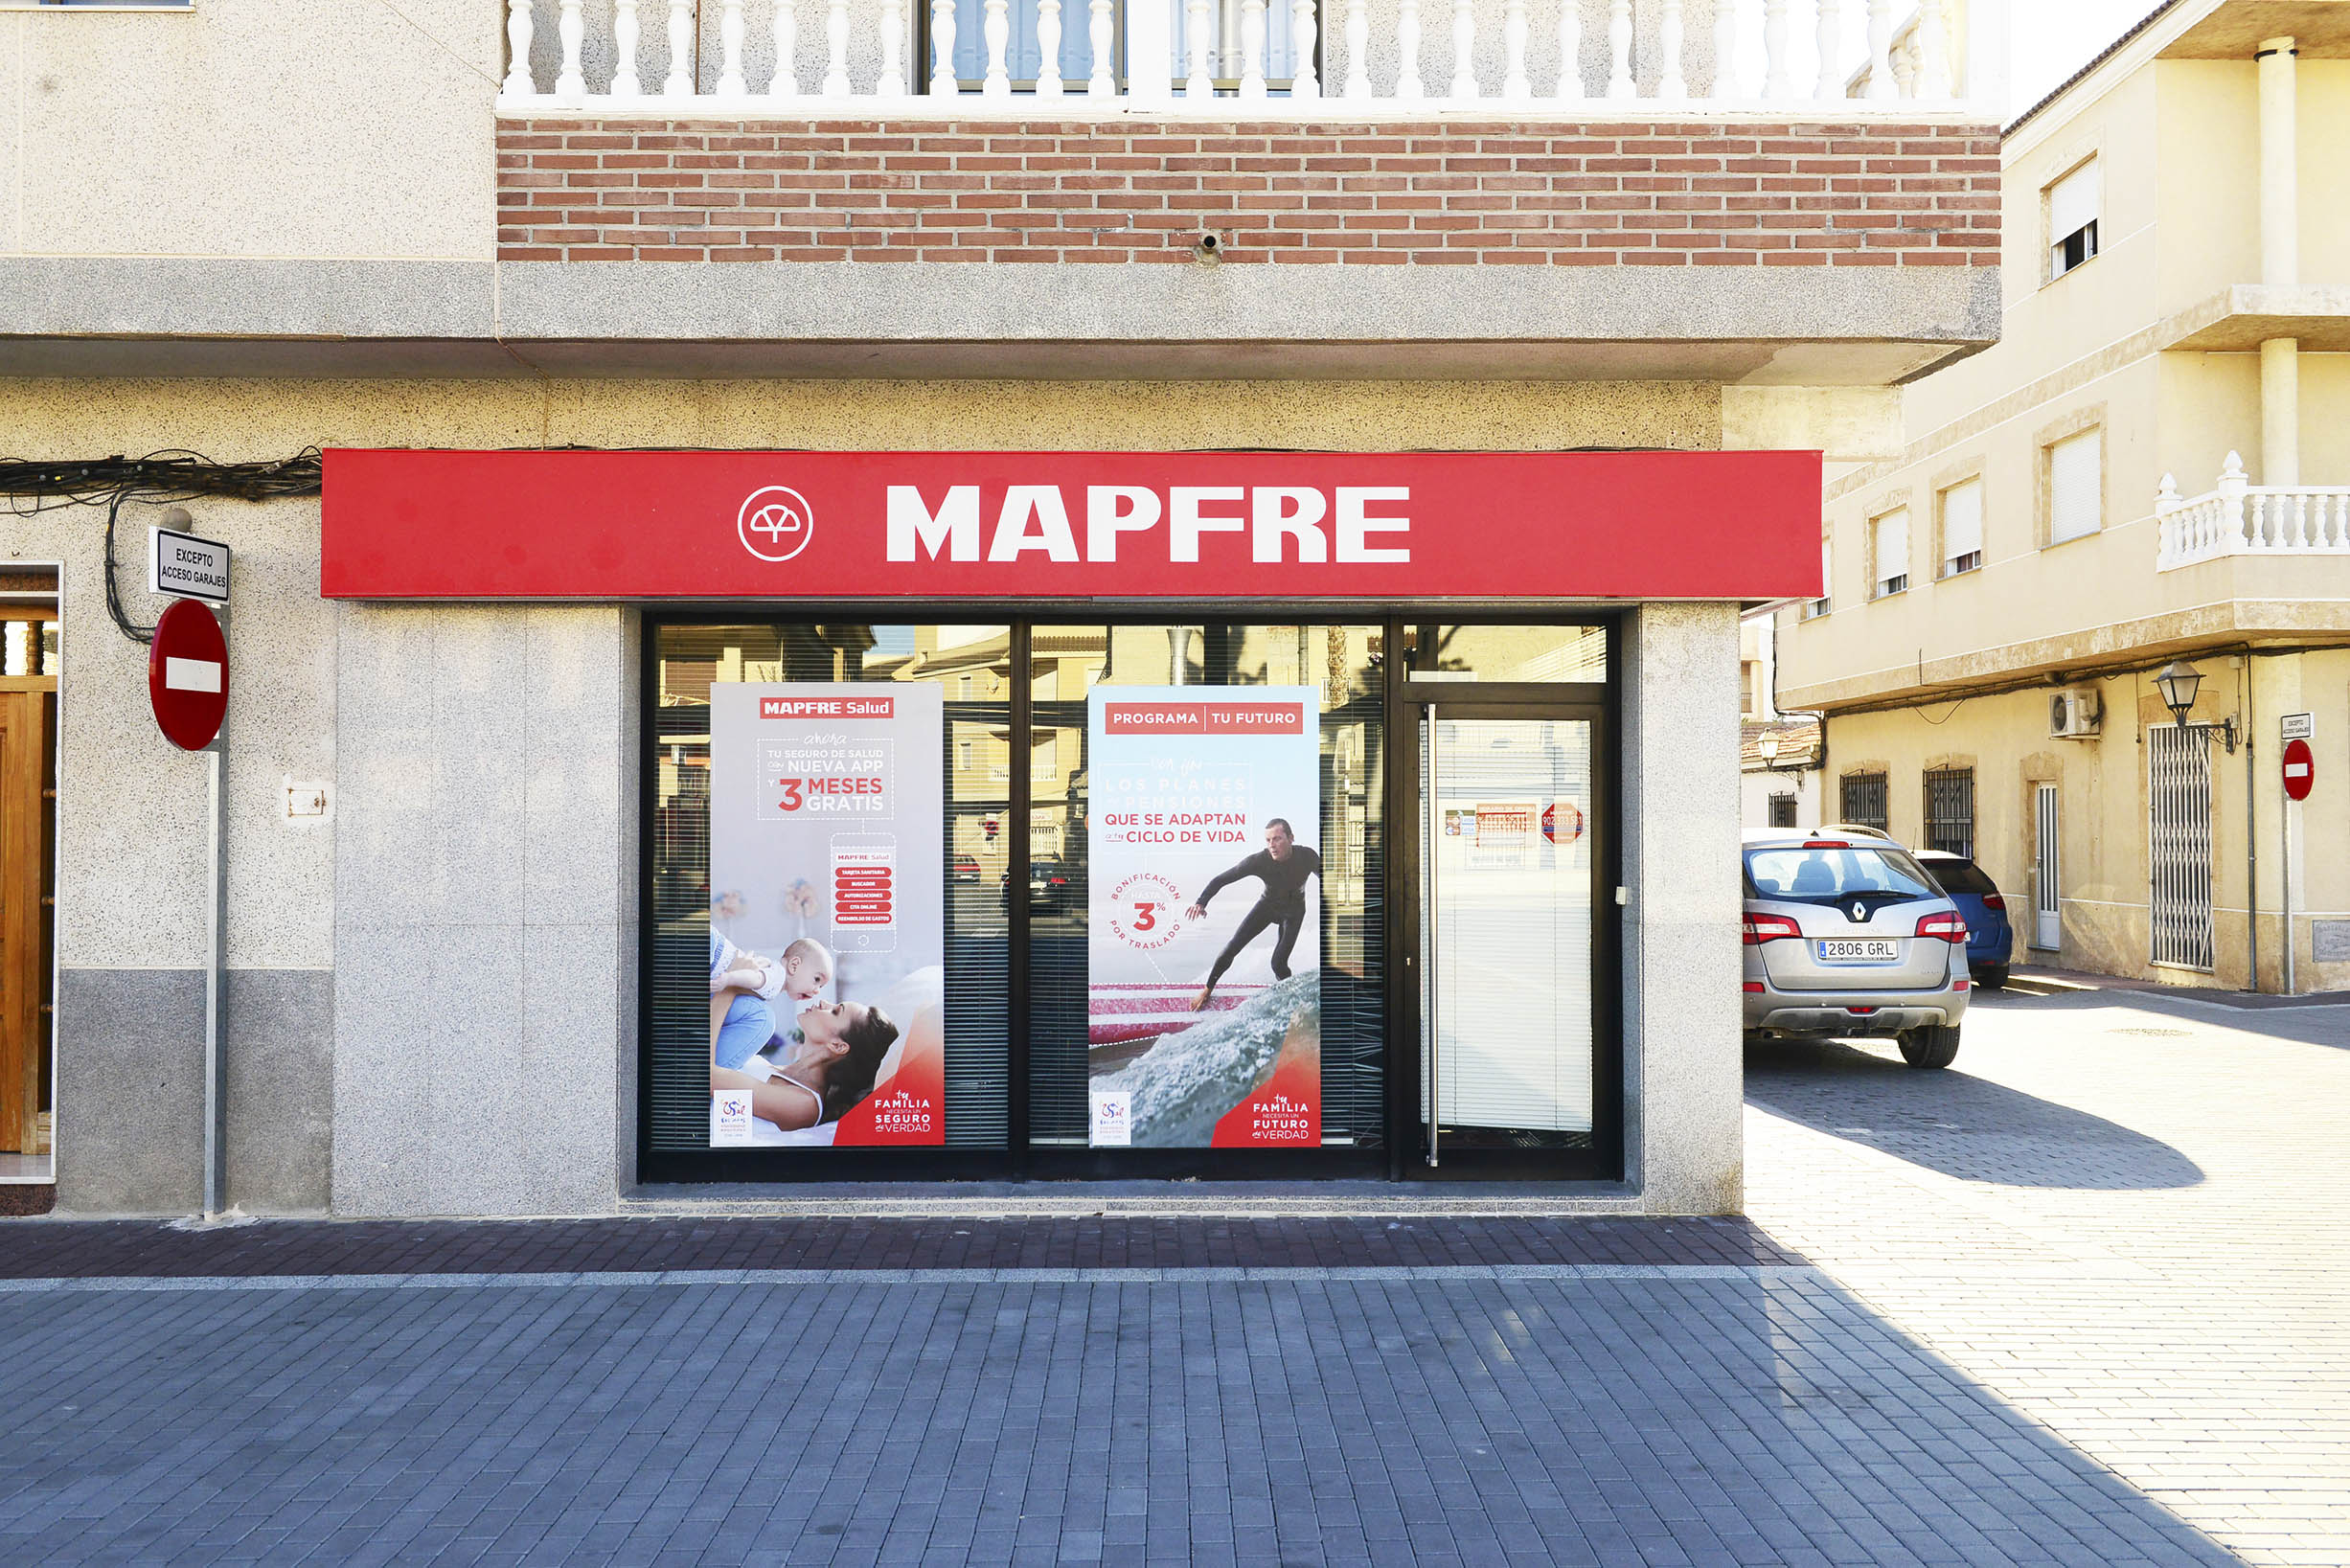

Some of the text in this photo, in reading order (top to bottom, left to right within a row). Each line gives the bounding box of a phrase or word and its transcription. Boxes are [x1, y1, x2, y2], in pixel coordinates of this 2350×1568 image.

[886, 485, 1410, 563] MAPFRE
[176, 548, 213, 567] EXCEPTO
[162, 565, 226, 587] ACCESO GARAJES
[764, 700, 889, 715] MAPFRE Salud
[1113, 713, 1296, 724] PROGRAMA TU FUTURO
[803, 733, 848, 745] ahora
[767, 750, 883, 759] TU SEGURO DE SALUD
[787, 761, 846, 773] NUEVA
[851, 761, 883, 773] APP
[1105, 779, 1245, 791] LOS PLANES
[778, 778, 803, 811] 3
[808, 778, 882, 794] MESES
[807, 796, 883, 811] GRATIS
[1126, 796, 1246, 809] PENSIONES
[1105, 813, 1245, 826] QUE SE ADAPTAN
[1542, 815, 1555, 826] 902
[1127, 830, 1175, 843] CICLO
[1180, 830, 1201, 843] DE
[1207, 830, 1245, 843] VIDA
[1110, 920, 1126, 940] POR
[1828, 943, 1894, 956] 2806 GRL
[896, 1089, 909, 1101] tu
[1273, 1093, 1288, 1103] tu
[875, 1100, 930, 1108] FAMILIA
[1253, 1103, 1309, 1112] FAMILIA
[875, 1114, 930, 1124] SEGURO
[1253, 1120, 1309, 1128] FUTURO
[885, 1124, 931, 1132] VERDAD
[1262, 1130, 1309, 1139] VERDAD
